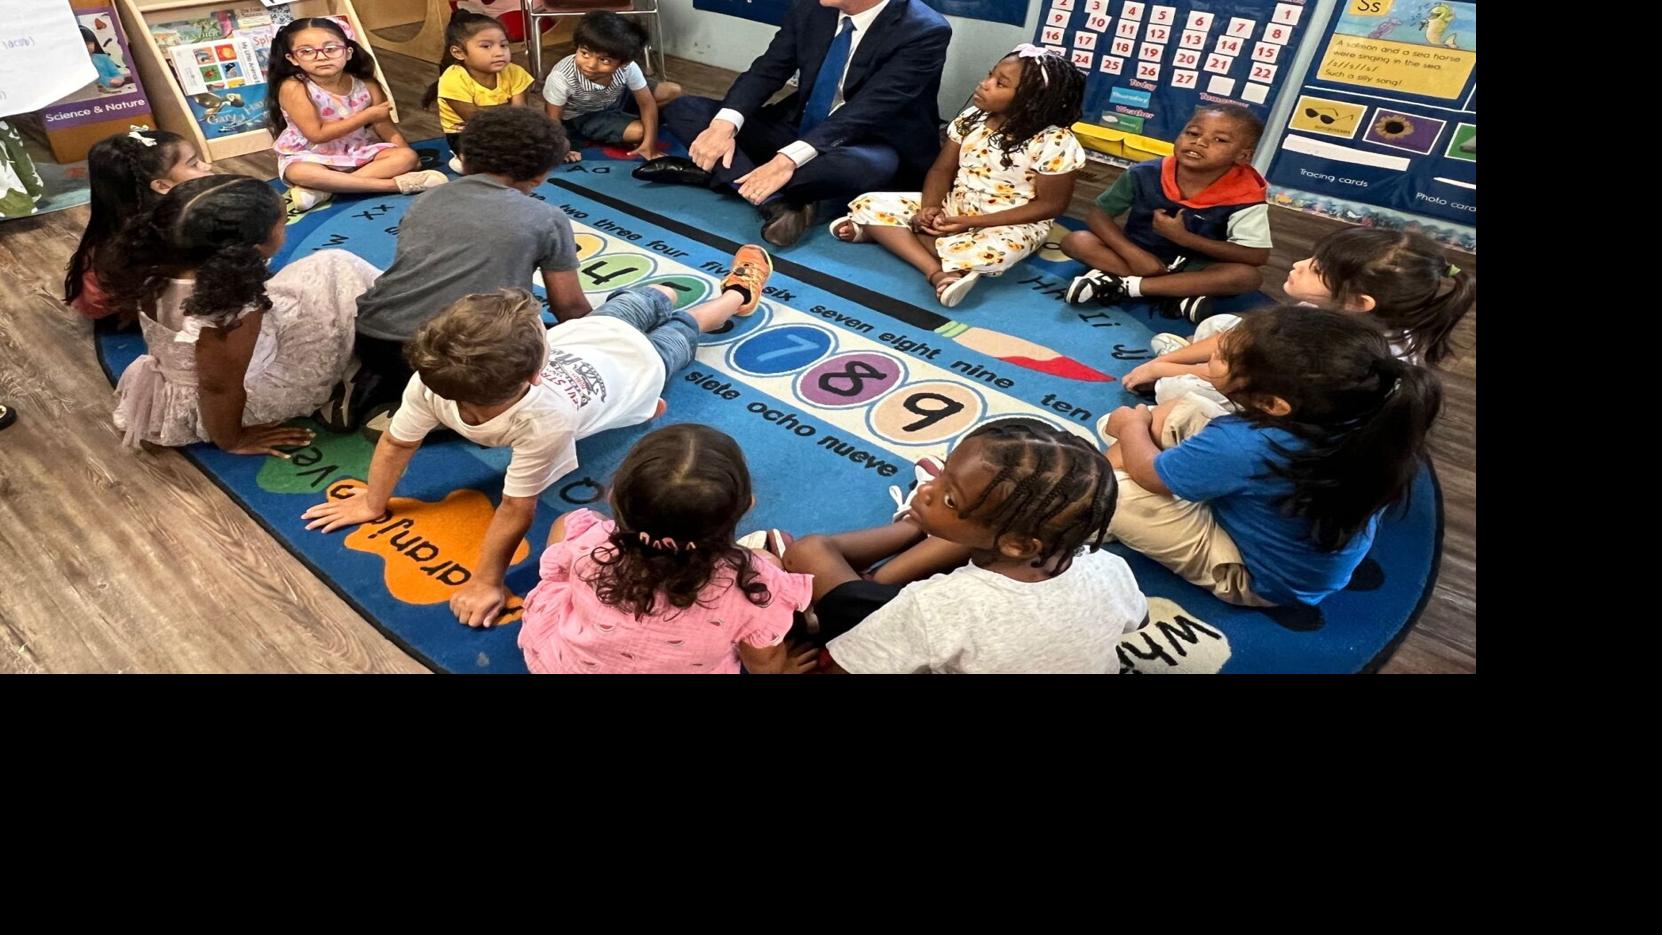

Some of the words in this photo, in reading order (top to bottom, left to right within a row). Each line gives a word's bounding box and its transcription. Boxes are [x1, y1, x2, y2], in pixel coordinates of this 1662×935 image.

[1092, 1, 1101, 10] 3
[1127, 6, 1138, 16] 4
[1158, 10, 1167, 20] 5
[1195, 16, 1205, 27] 6
[1235, 23, 1245, 33] 7
[1284, 10, 1292, 20] 1
[1357, 0, 1381, 13] Ss
[1054, 14, 1064, 23] 9
[1092, 16, 1106, 27] 10
[1120, 24, 1135, 35] 11
[1150, 28, 1165, 39] 12
[1185, 34, 1202, 46] 13
[1221, 40, 1237, 52] 14
[1271, 28, 1282, 39] 8
[1045, 31, 1060, 41] 16
[1078, 36, 1093, 45] 17
[1116, 42, 1130, 53] 18
[1144, 47, 1159, 58] 19
[1178, 54, 1195, 65] 20
[1210, 58, 1227, 69] 21
[1257, 46, 1274, 58] 15
[1333, 51, 1355, 59] were
[1358, 52, 1390, 64] singing
[1404, 59, 1420, 68] the
[1381, 46, 1400, 54] and
[1413, 50, 1430, 58] sea
[1433, 52, 1461, 63] horse
[1074, 54, 1089, 65] 24
[1104, 59, 1119, 70] 25
[1141, 66, 1156, 77] 26
[1177, 73, 1194, 84] 27
[1254, 67, 1271, 79] 22
[1325, 69, 1345, 78] Such
[1357, 75, 1373, 83] silly
[1376, 77, 1403, 87] song!
[45, 108, 91, 122] Science
[93, 105, 103, 114] &
[105, 98, 145, 112] Nature
[567, 164, 610, 174] Aa
[1300, 168, 1335, 184] Tracing
[1338, 175, 1369, 188] cards
[1415, 192, 1447, 206] Photo
[581, 261, 638, 286] 4
[560, 204, 589, 219] two
[593, 218, 643, 242] three
[646, 239, 689, 258] four
[762, 286, 797, 301] six
[810, 304, 876, 333] seven
[879, 330, 943, 361] eight
[951, 358, 1015, 390] nine
[1041, 392, 1092, 421] ten
[756, 334, 820, 363] 7
[818, 361, 887, 397] 8
[902, 392, 965, 433] 9
[684, 369, 741, 401] siete
[746, 401, 816, 437] ocho
[817, 434, 899, 477] nueve
